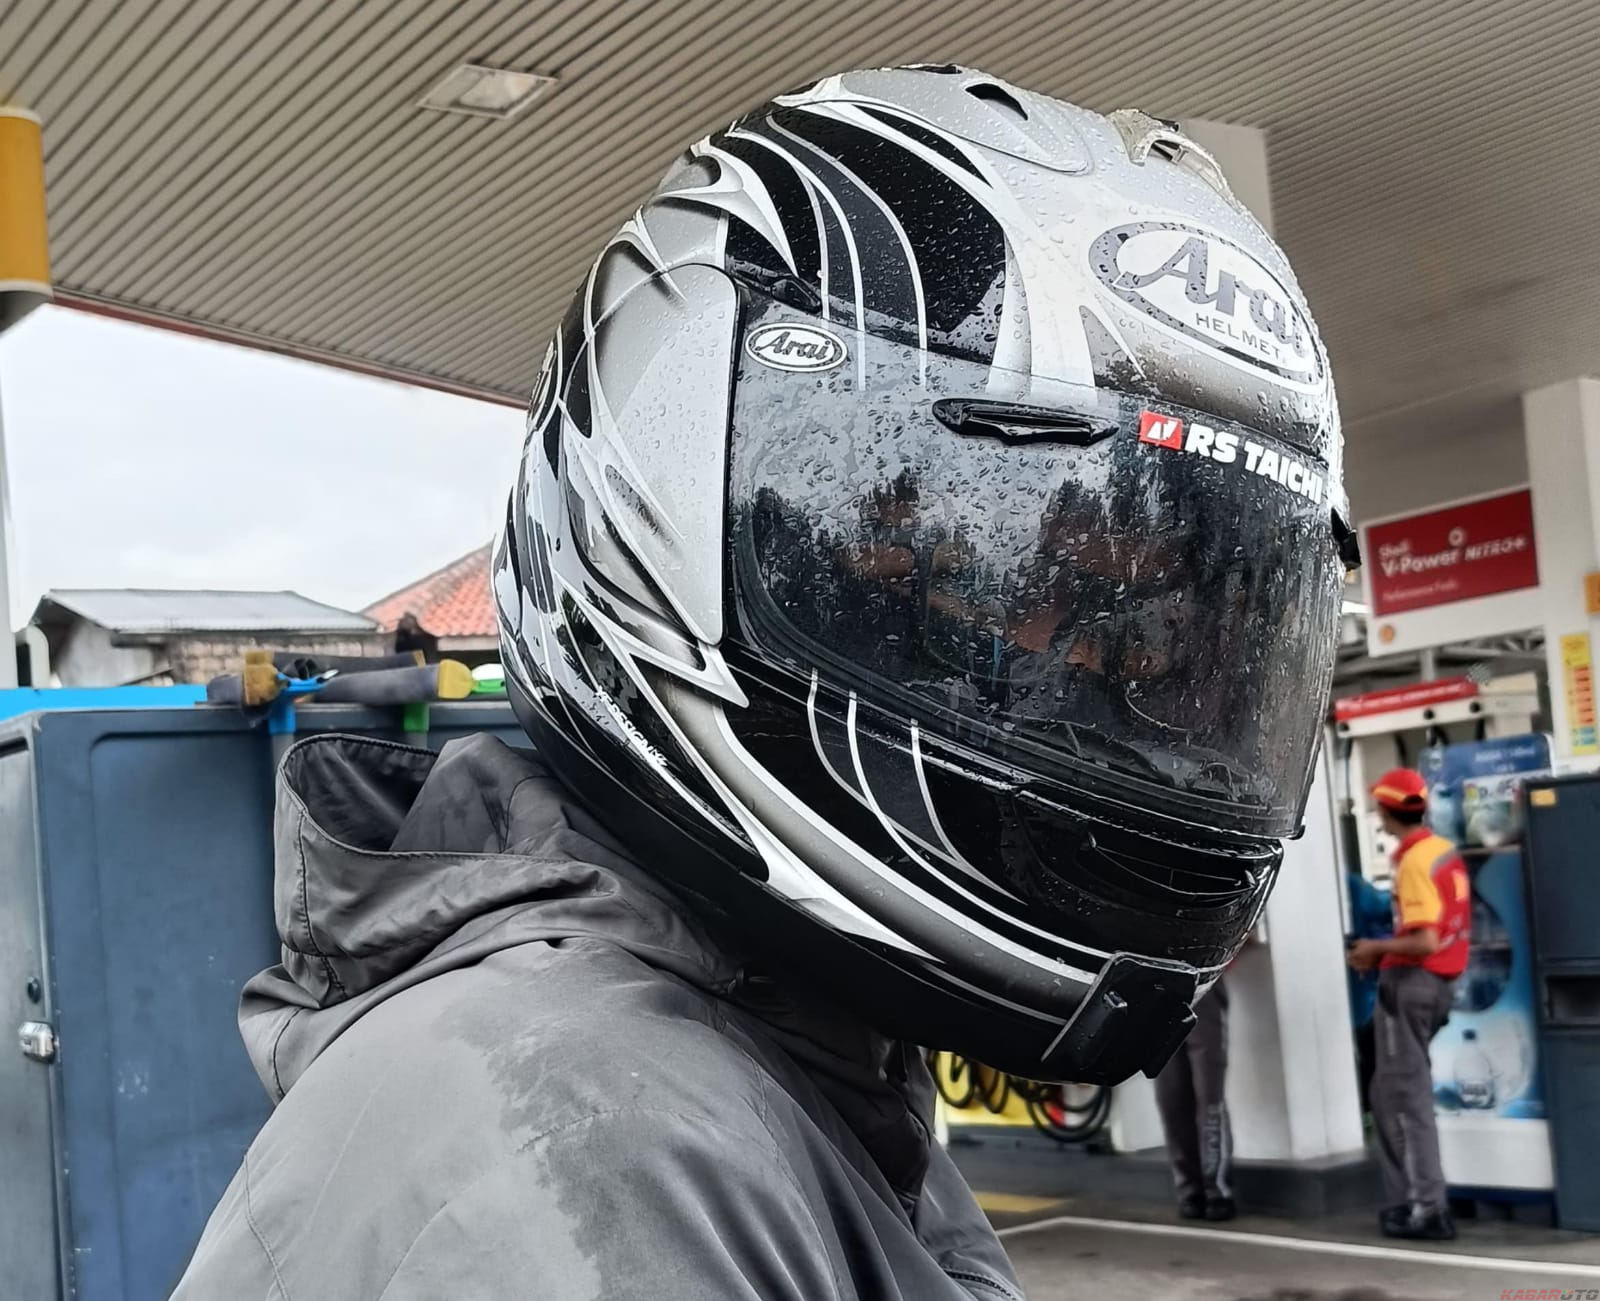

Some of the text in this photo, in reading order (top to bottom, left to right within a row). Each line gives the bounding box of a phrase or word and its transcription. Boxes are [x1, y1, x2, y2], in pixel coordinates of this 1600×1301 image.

[755, 331, 831, 360] Arai
[1195, 312, 1280, 359] HELMET
[1185, 424, 1324, 504] RS TAICHI
[1381, 549, 1459, 577] V-Power
